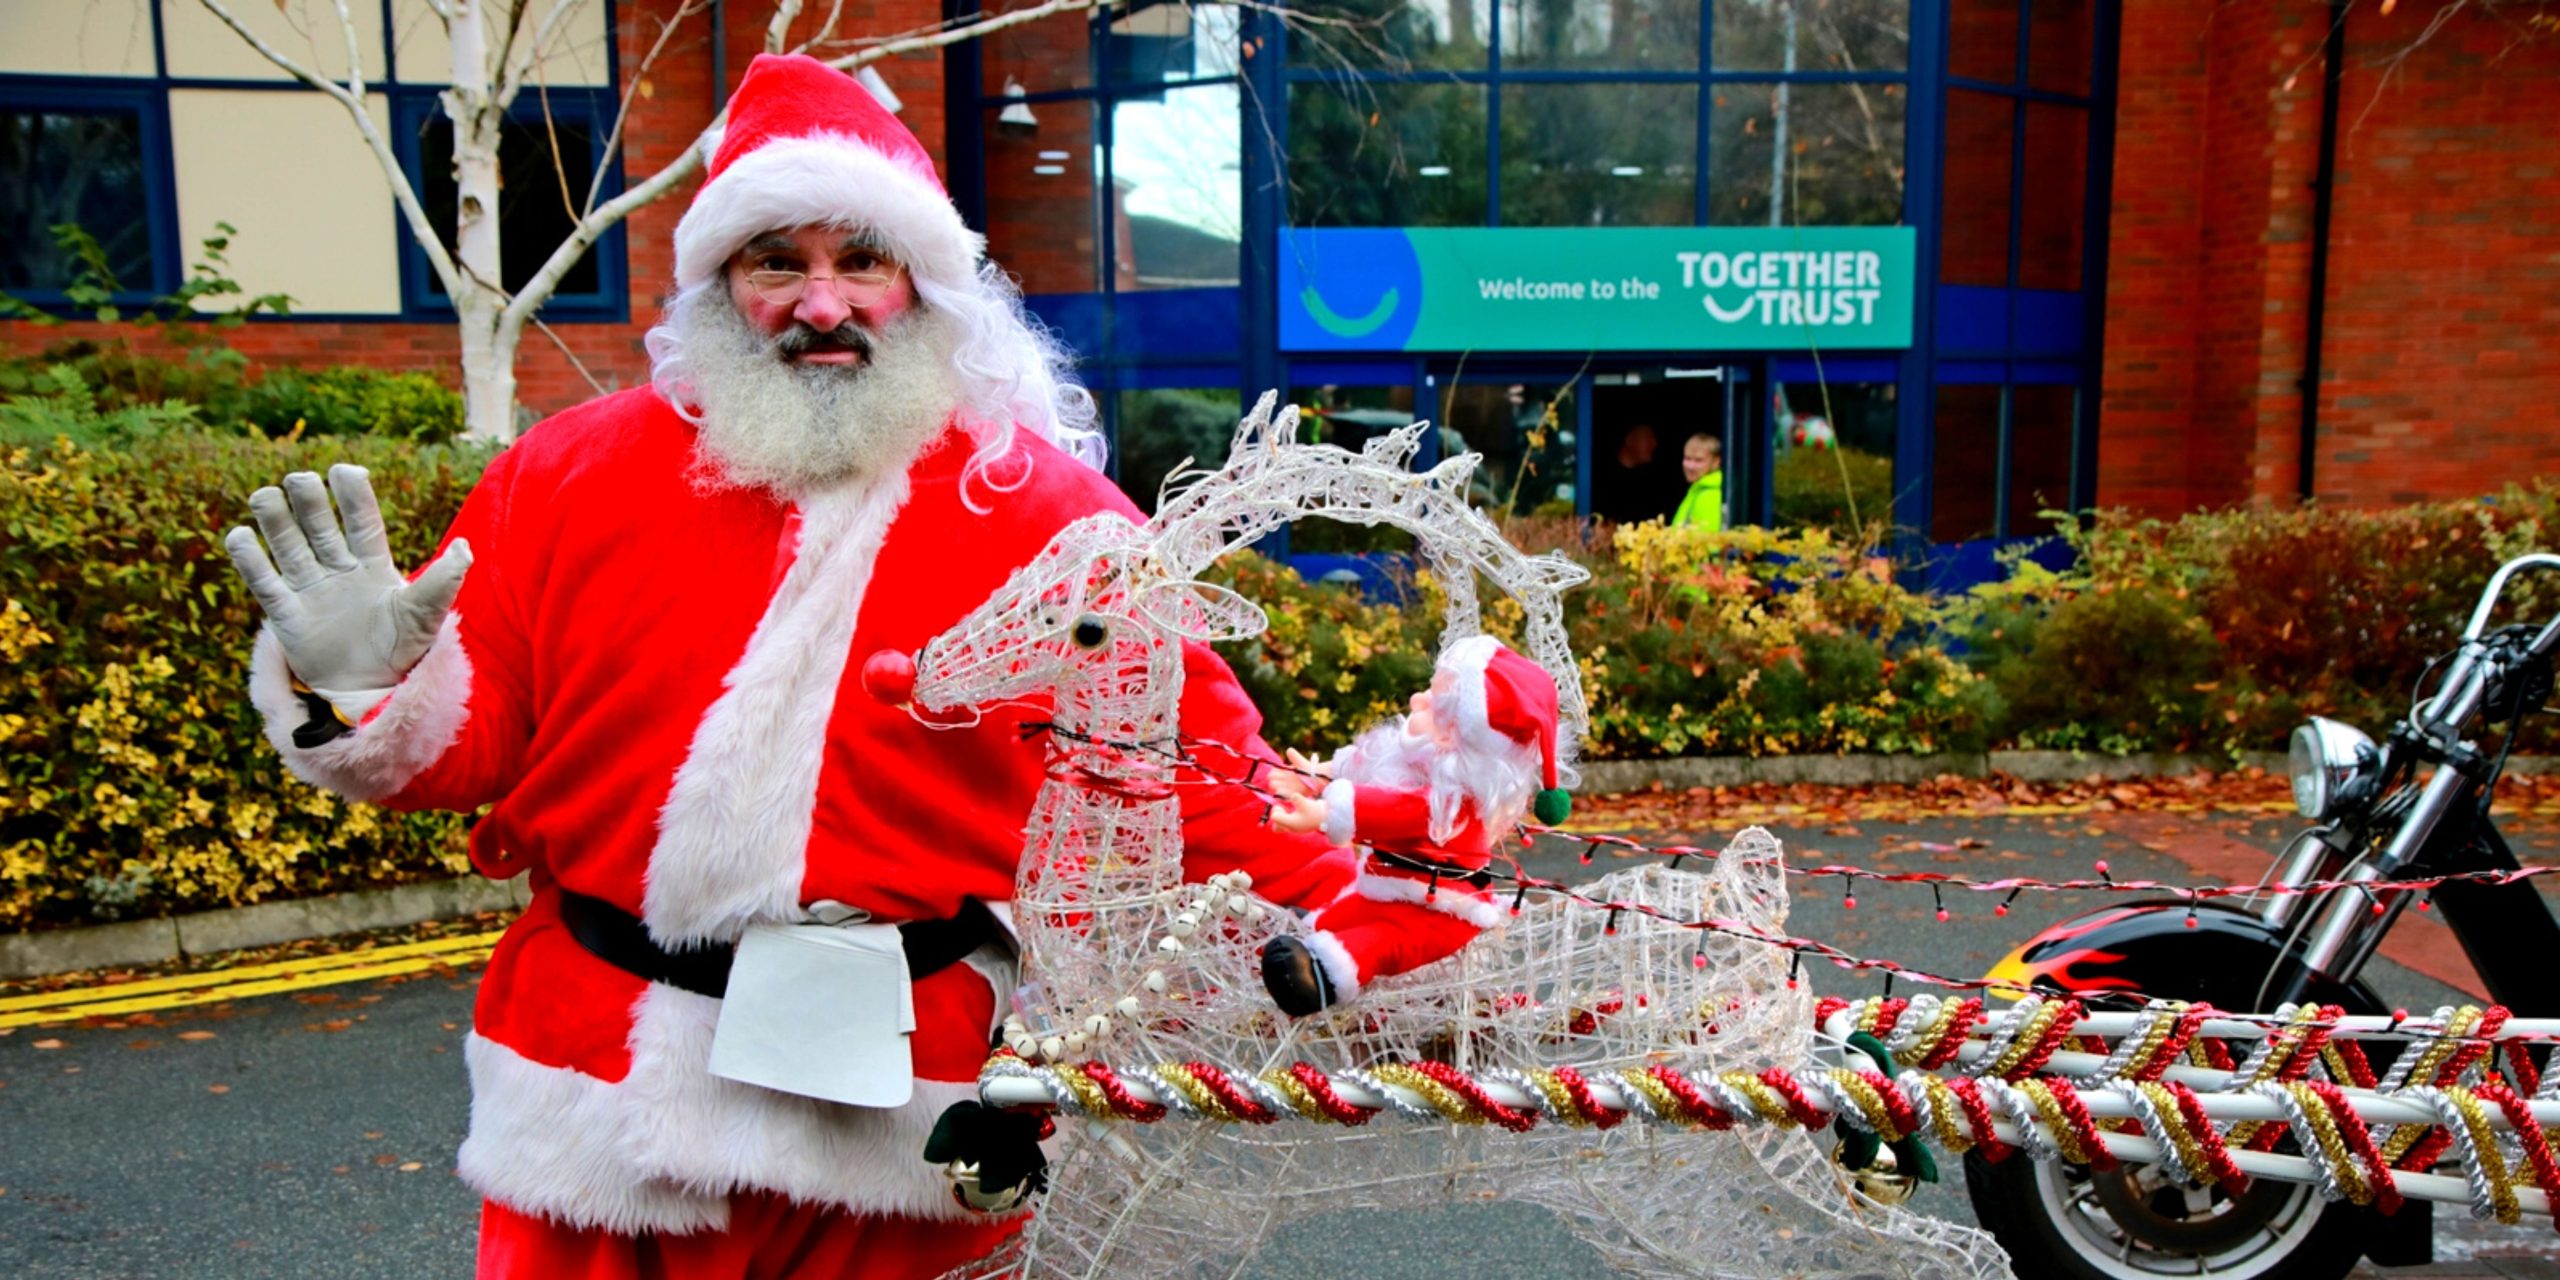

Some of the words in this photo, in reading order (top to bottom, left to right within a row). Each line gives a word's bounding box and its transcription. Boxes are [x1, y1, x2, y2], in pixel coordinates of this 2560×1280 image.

[1676, 251, 1881, 288] TOGETHER
[1478, 277, 1585, 300] Welcome
[1590, 279, 1616, 300] to
[1621, 277, 1660, 300] the
[1754, 288, 1881, 326] TRUST
